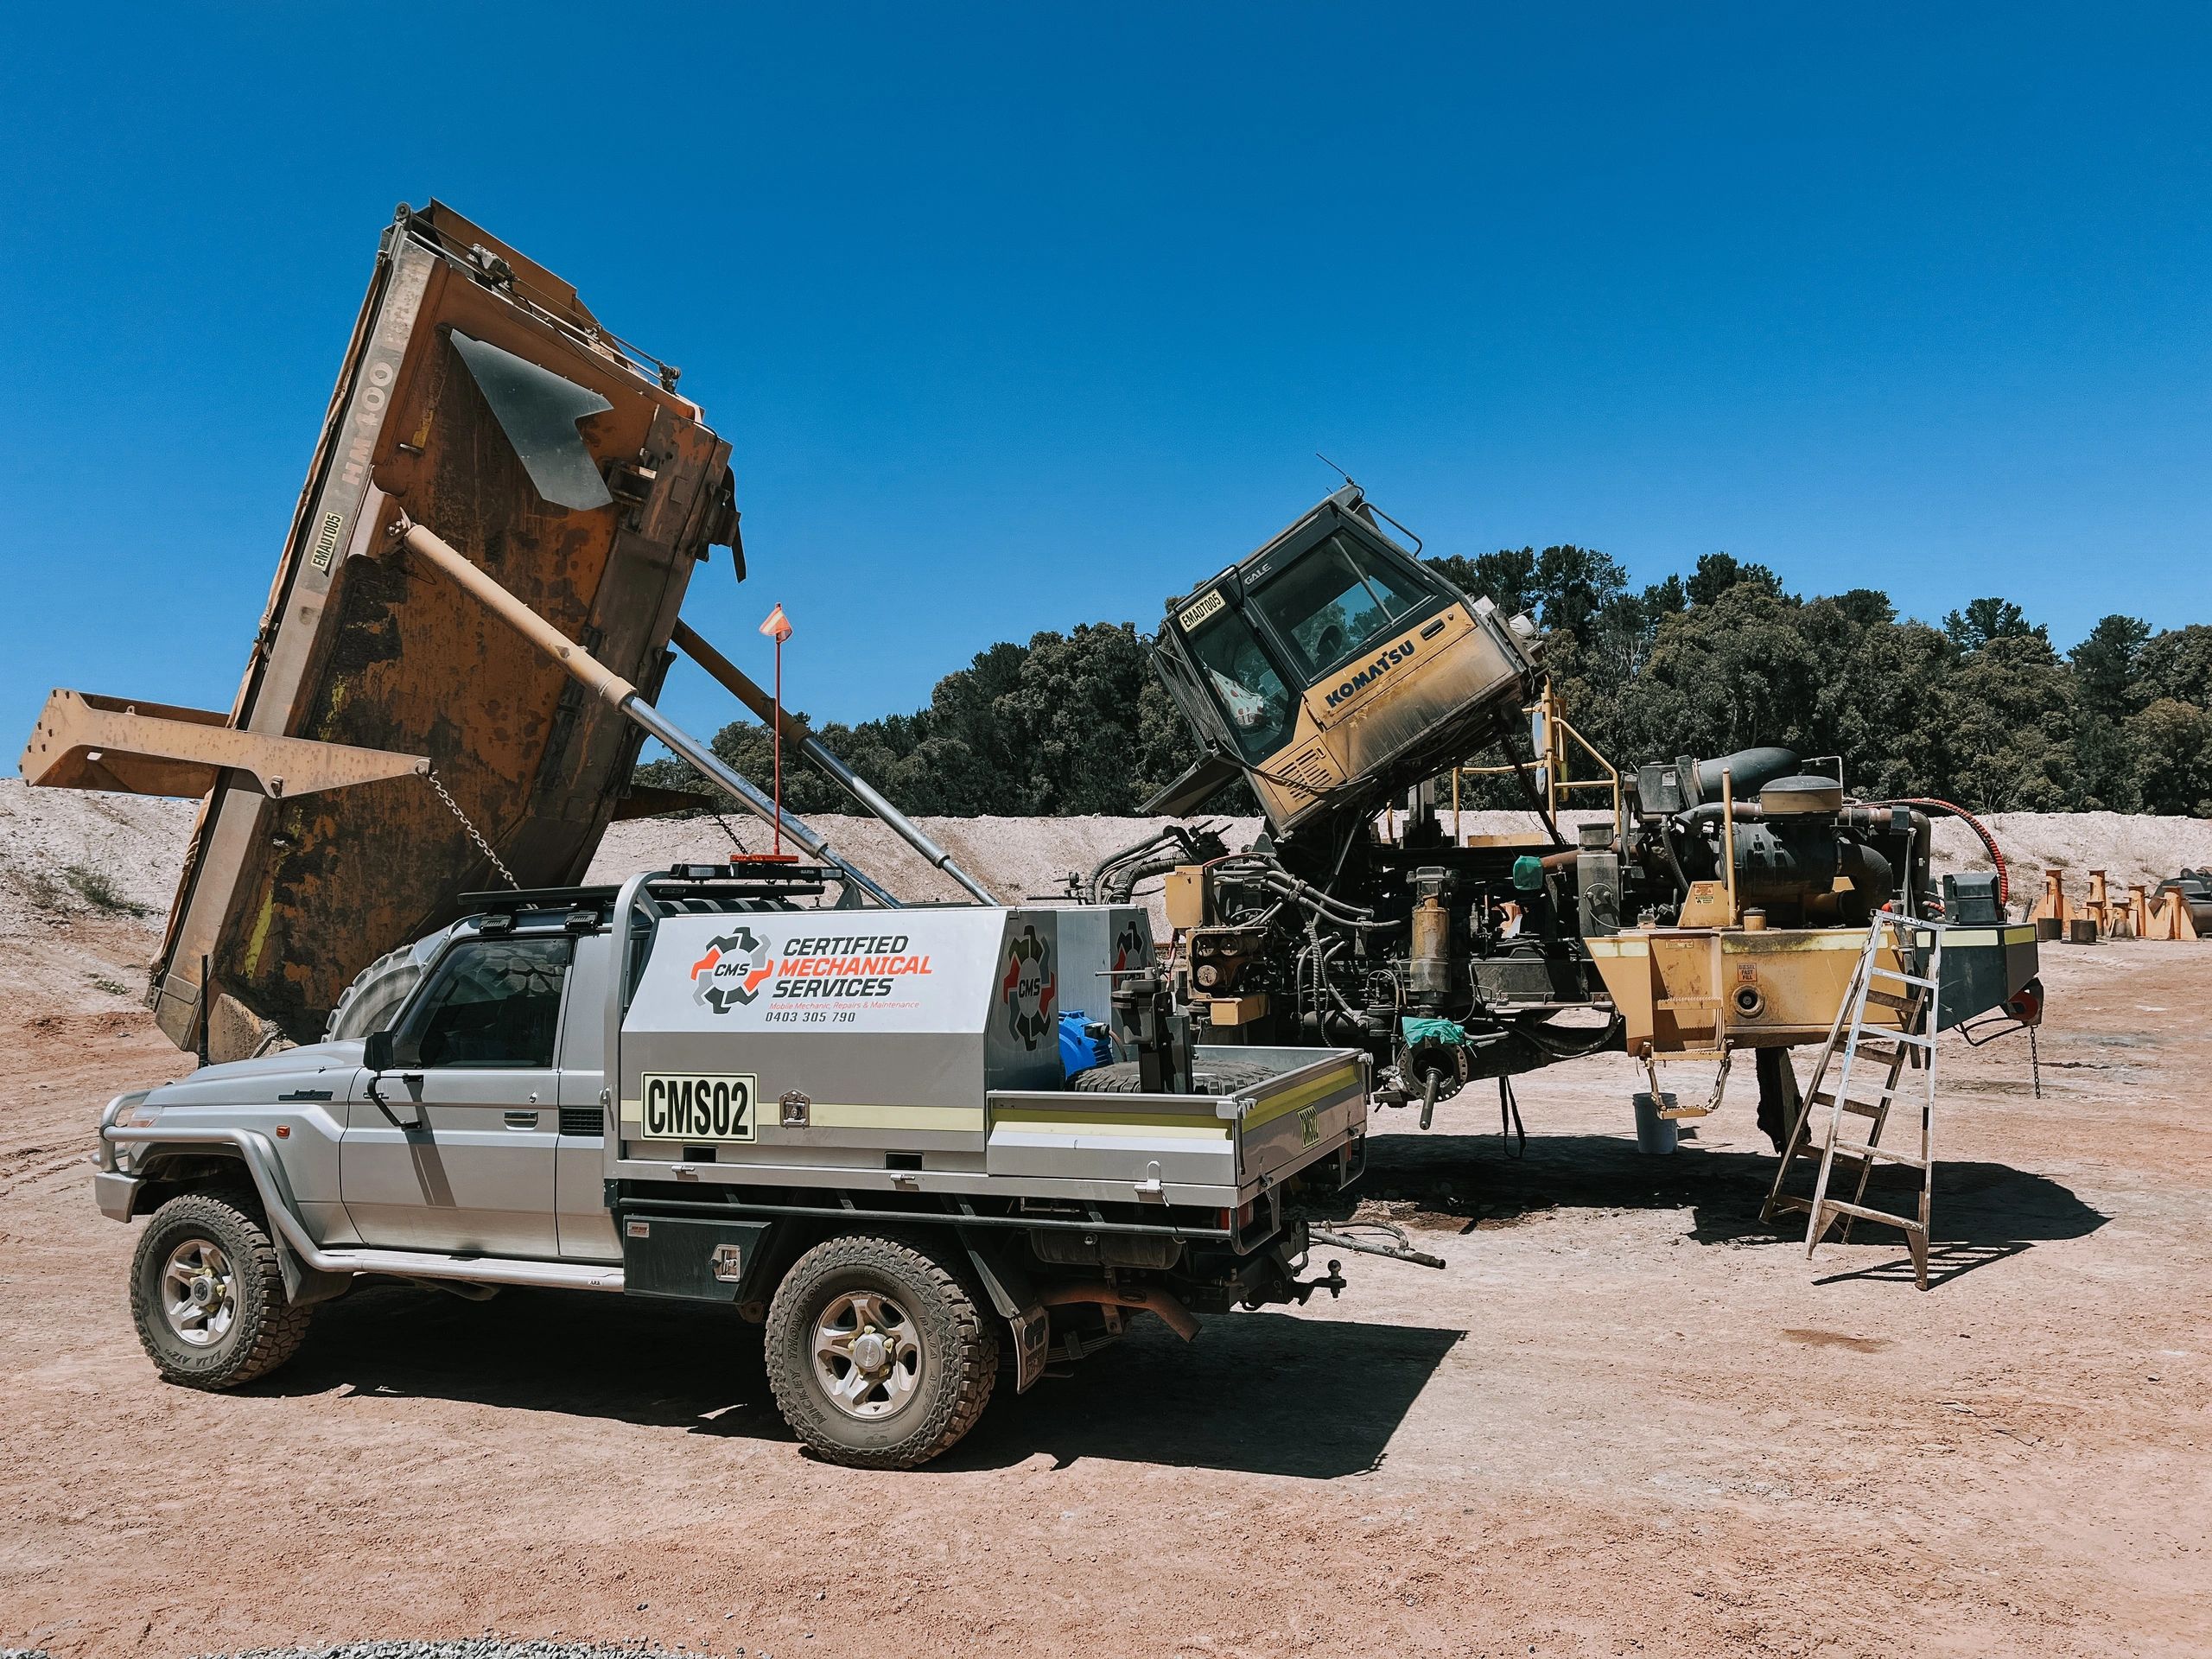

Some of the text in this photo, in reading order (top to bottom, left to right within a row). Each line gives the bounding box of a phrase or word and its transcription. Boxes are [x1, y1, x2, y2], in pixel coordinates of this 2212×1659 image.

[1181, 593, 1222, 628] EMADT005
[1325, 639, 1415, 709] KOMATSU
[783, 935, 909, 957] CERTIFIED
[714, 963, 751, 976] CMS
[777, 956, 933, 977] MECHANICAL
[772, 976, 895, 998] SERVICES
[1019, 977, 1041, 998] CMS
[765, 1011, 856, 1022] 0403 305 790
[832, 1001, 861, 1010] Repairs
[870, 1001, 920, 1009] Maintenance
[648, 1078, 748, 1136] CMS02
[789, 1368, 829, 1425] MICKEY
